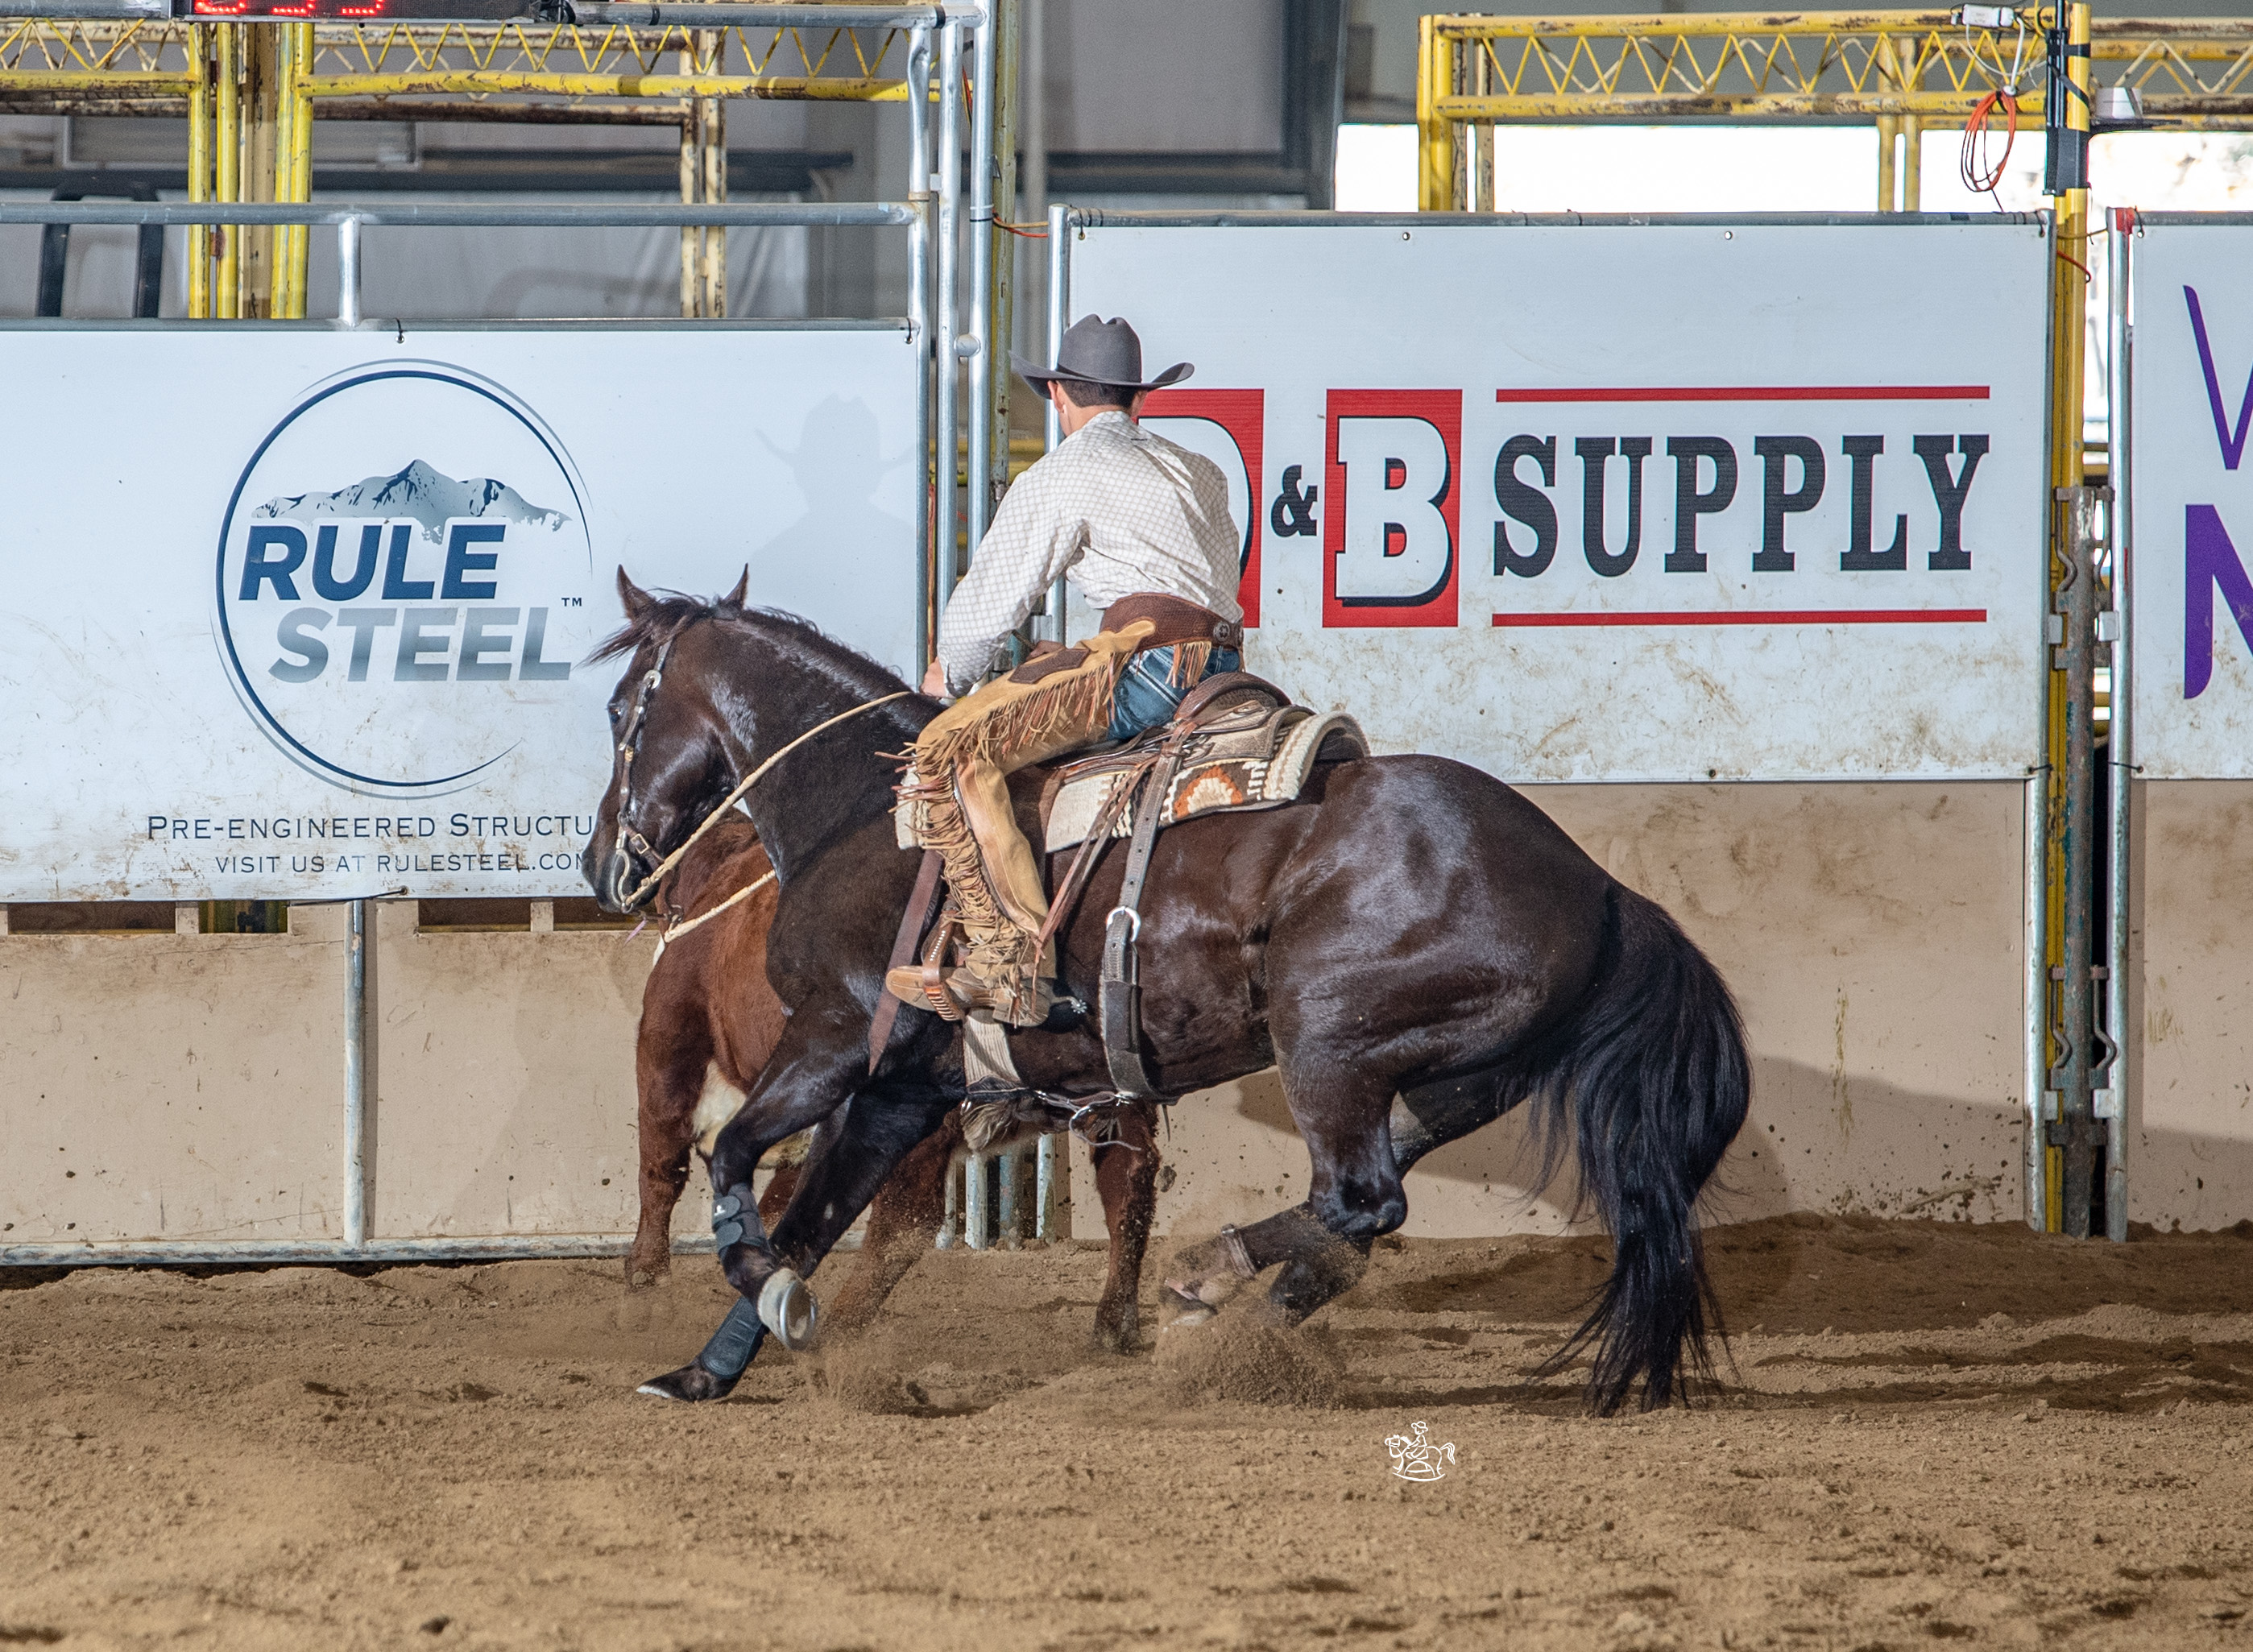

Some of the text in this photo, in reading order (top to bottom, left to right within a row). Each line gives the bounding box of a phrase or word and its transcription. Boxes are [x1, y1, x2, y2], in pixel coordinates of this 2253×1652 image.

[1270, 464, 1319, 538] &
[1335, 415, 1454, 607] B
[1493, 433, 1990, 578] SUPPLY
[238, 524, 507, 602] RULE
[267, 606, 573, 684] STEEL
[147, 813, 593, 839] PRE-ENGINEERED STRUCTU
[215, 855, 280, 874] VISIT
[292, 855, 325, 873] US
[335, 855, 366, 873] AT
